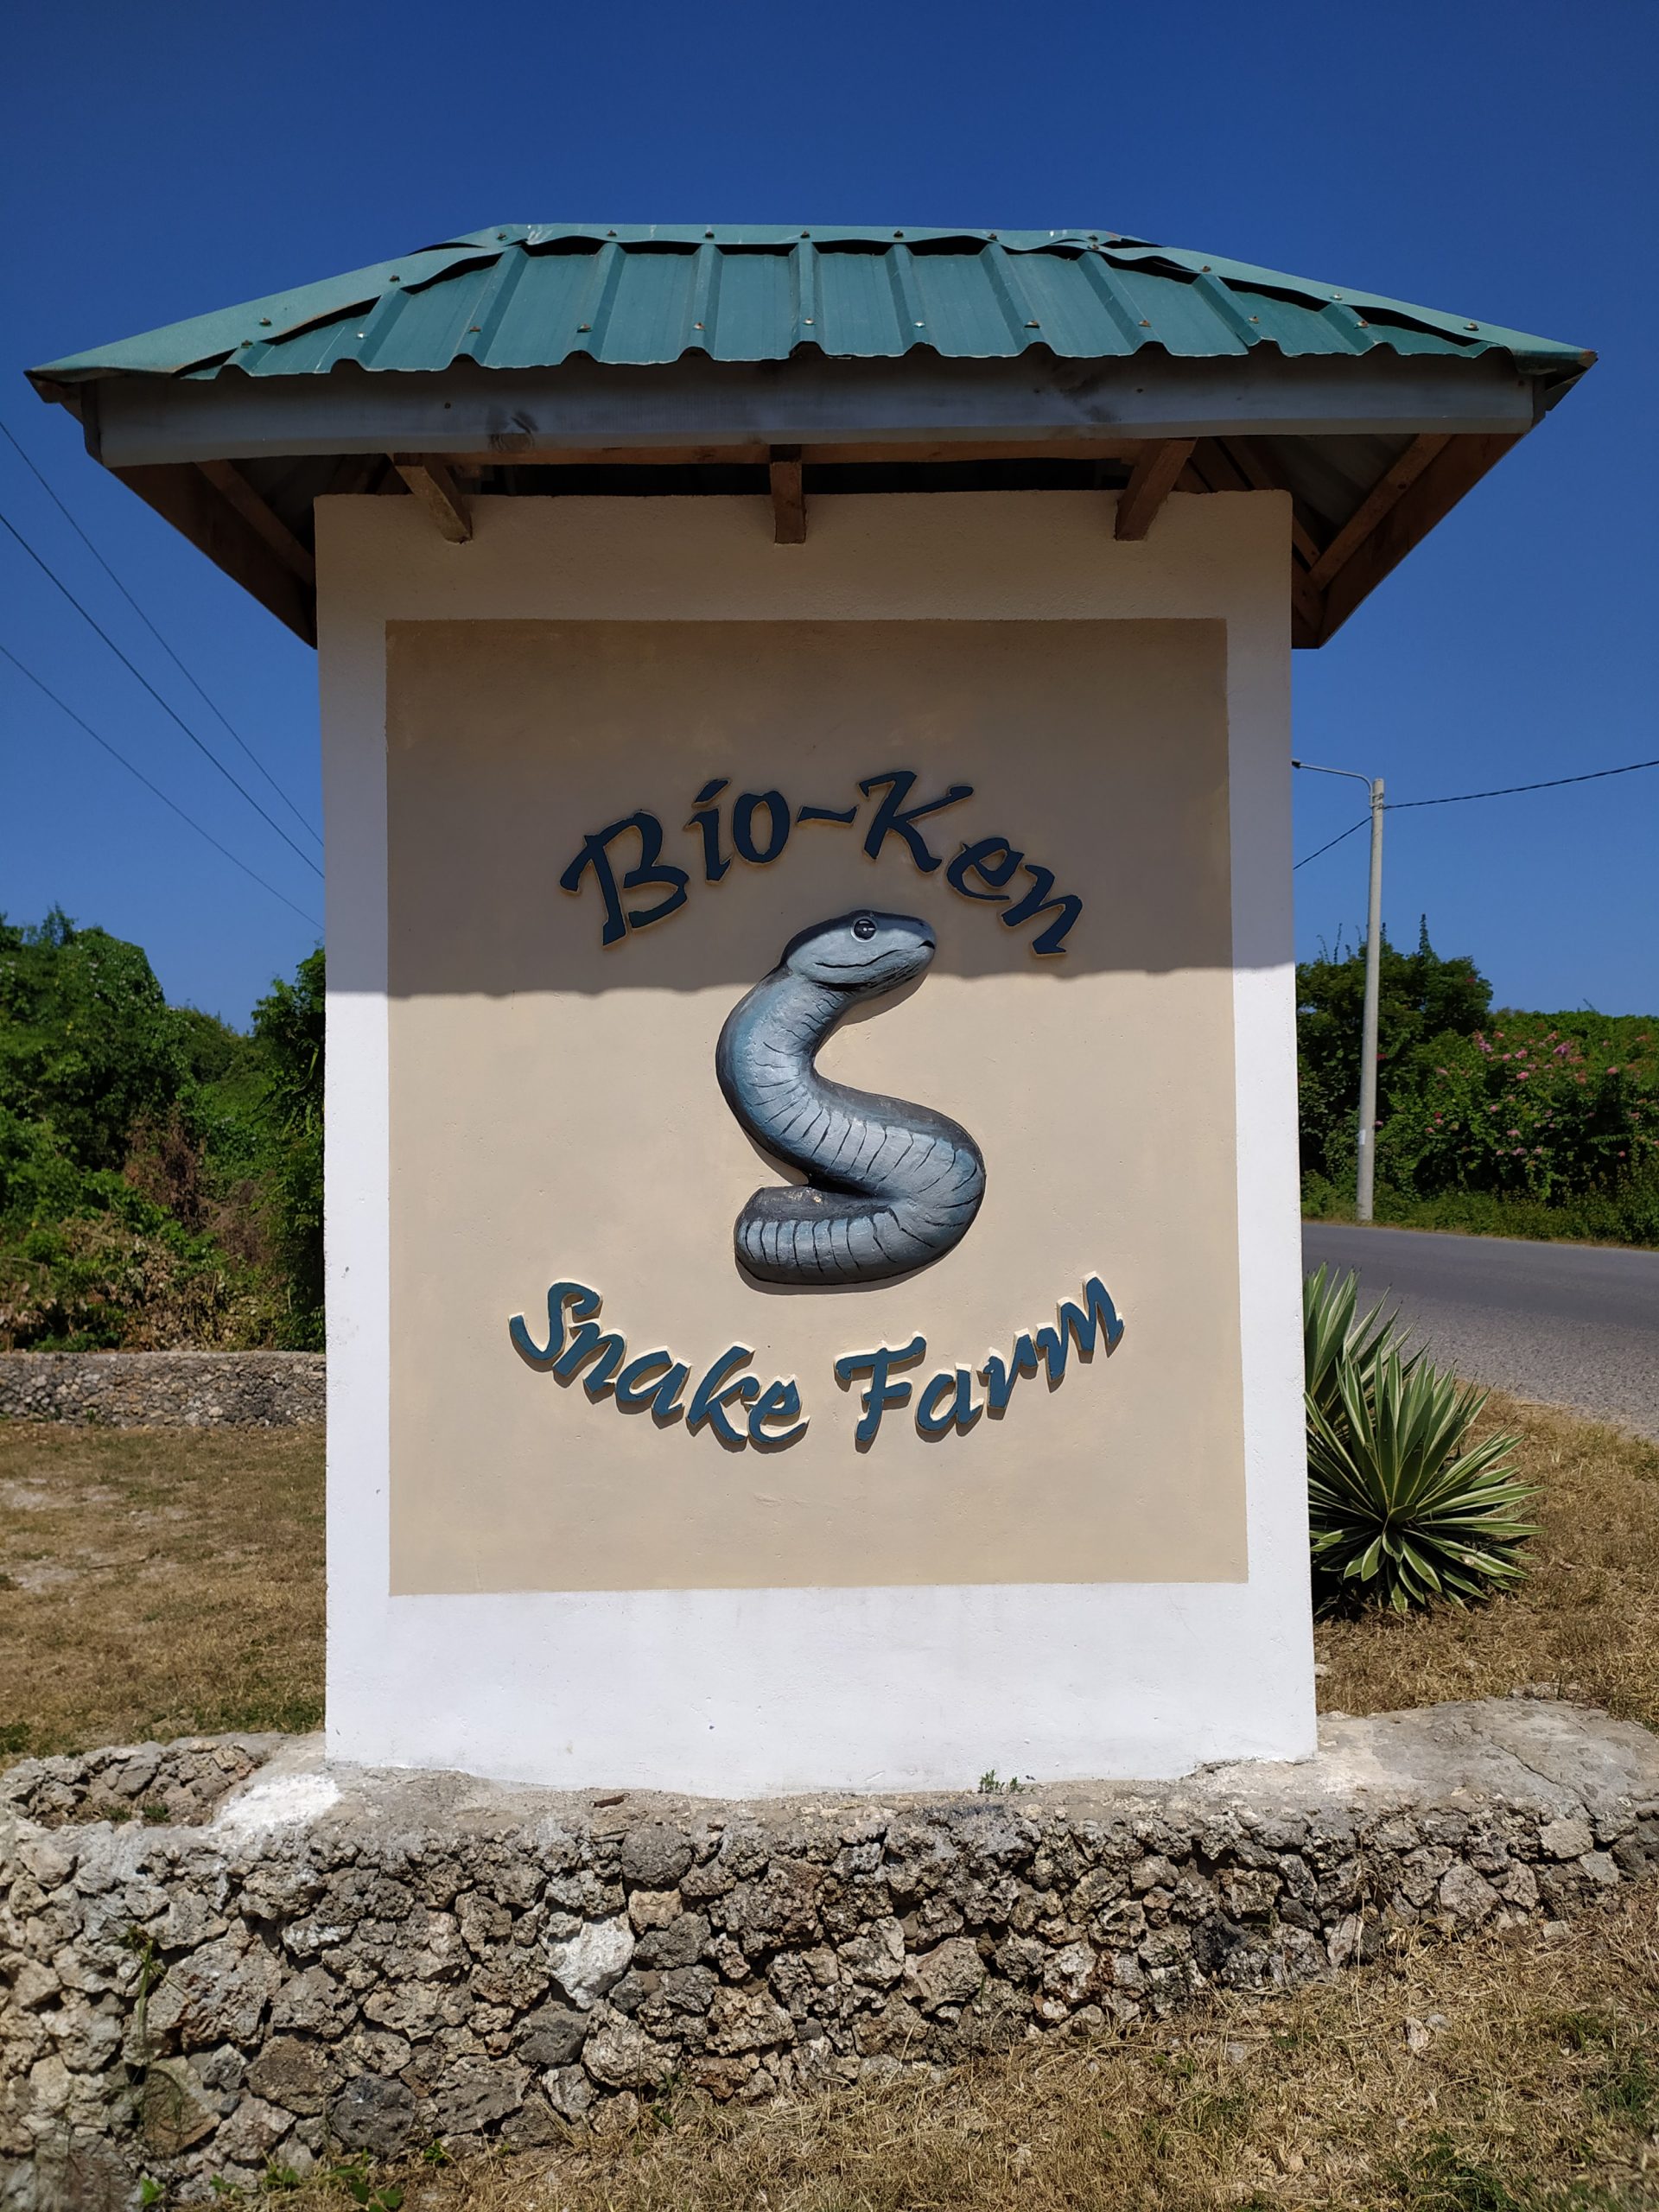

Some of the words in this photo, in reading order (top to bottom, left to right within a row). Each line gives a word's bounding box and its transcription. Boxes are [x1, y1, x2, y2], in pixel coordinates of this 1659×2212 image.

[559, 770, 1083, 954] Bio-Ken
[508, 1281, 810, 1445] Snake
[834, 1274, 1124, 1443] Farm
